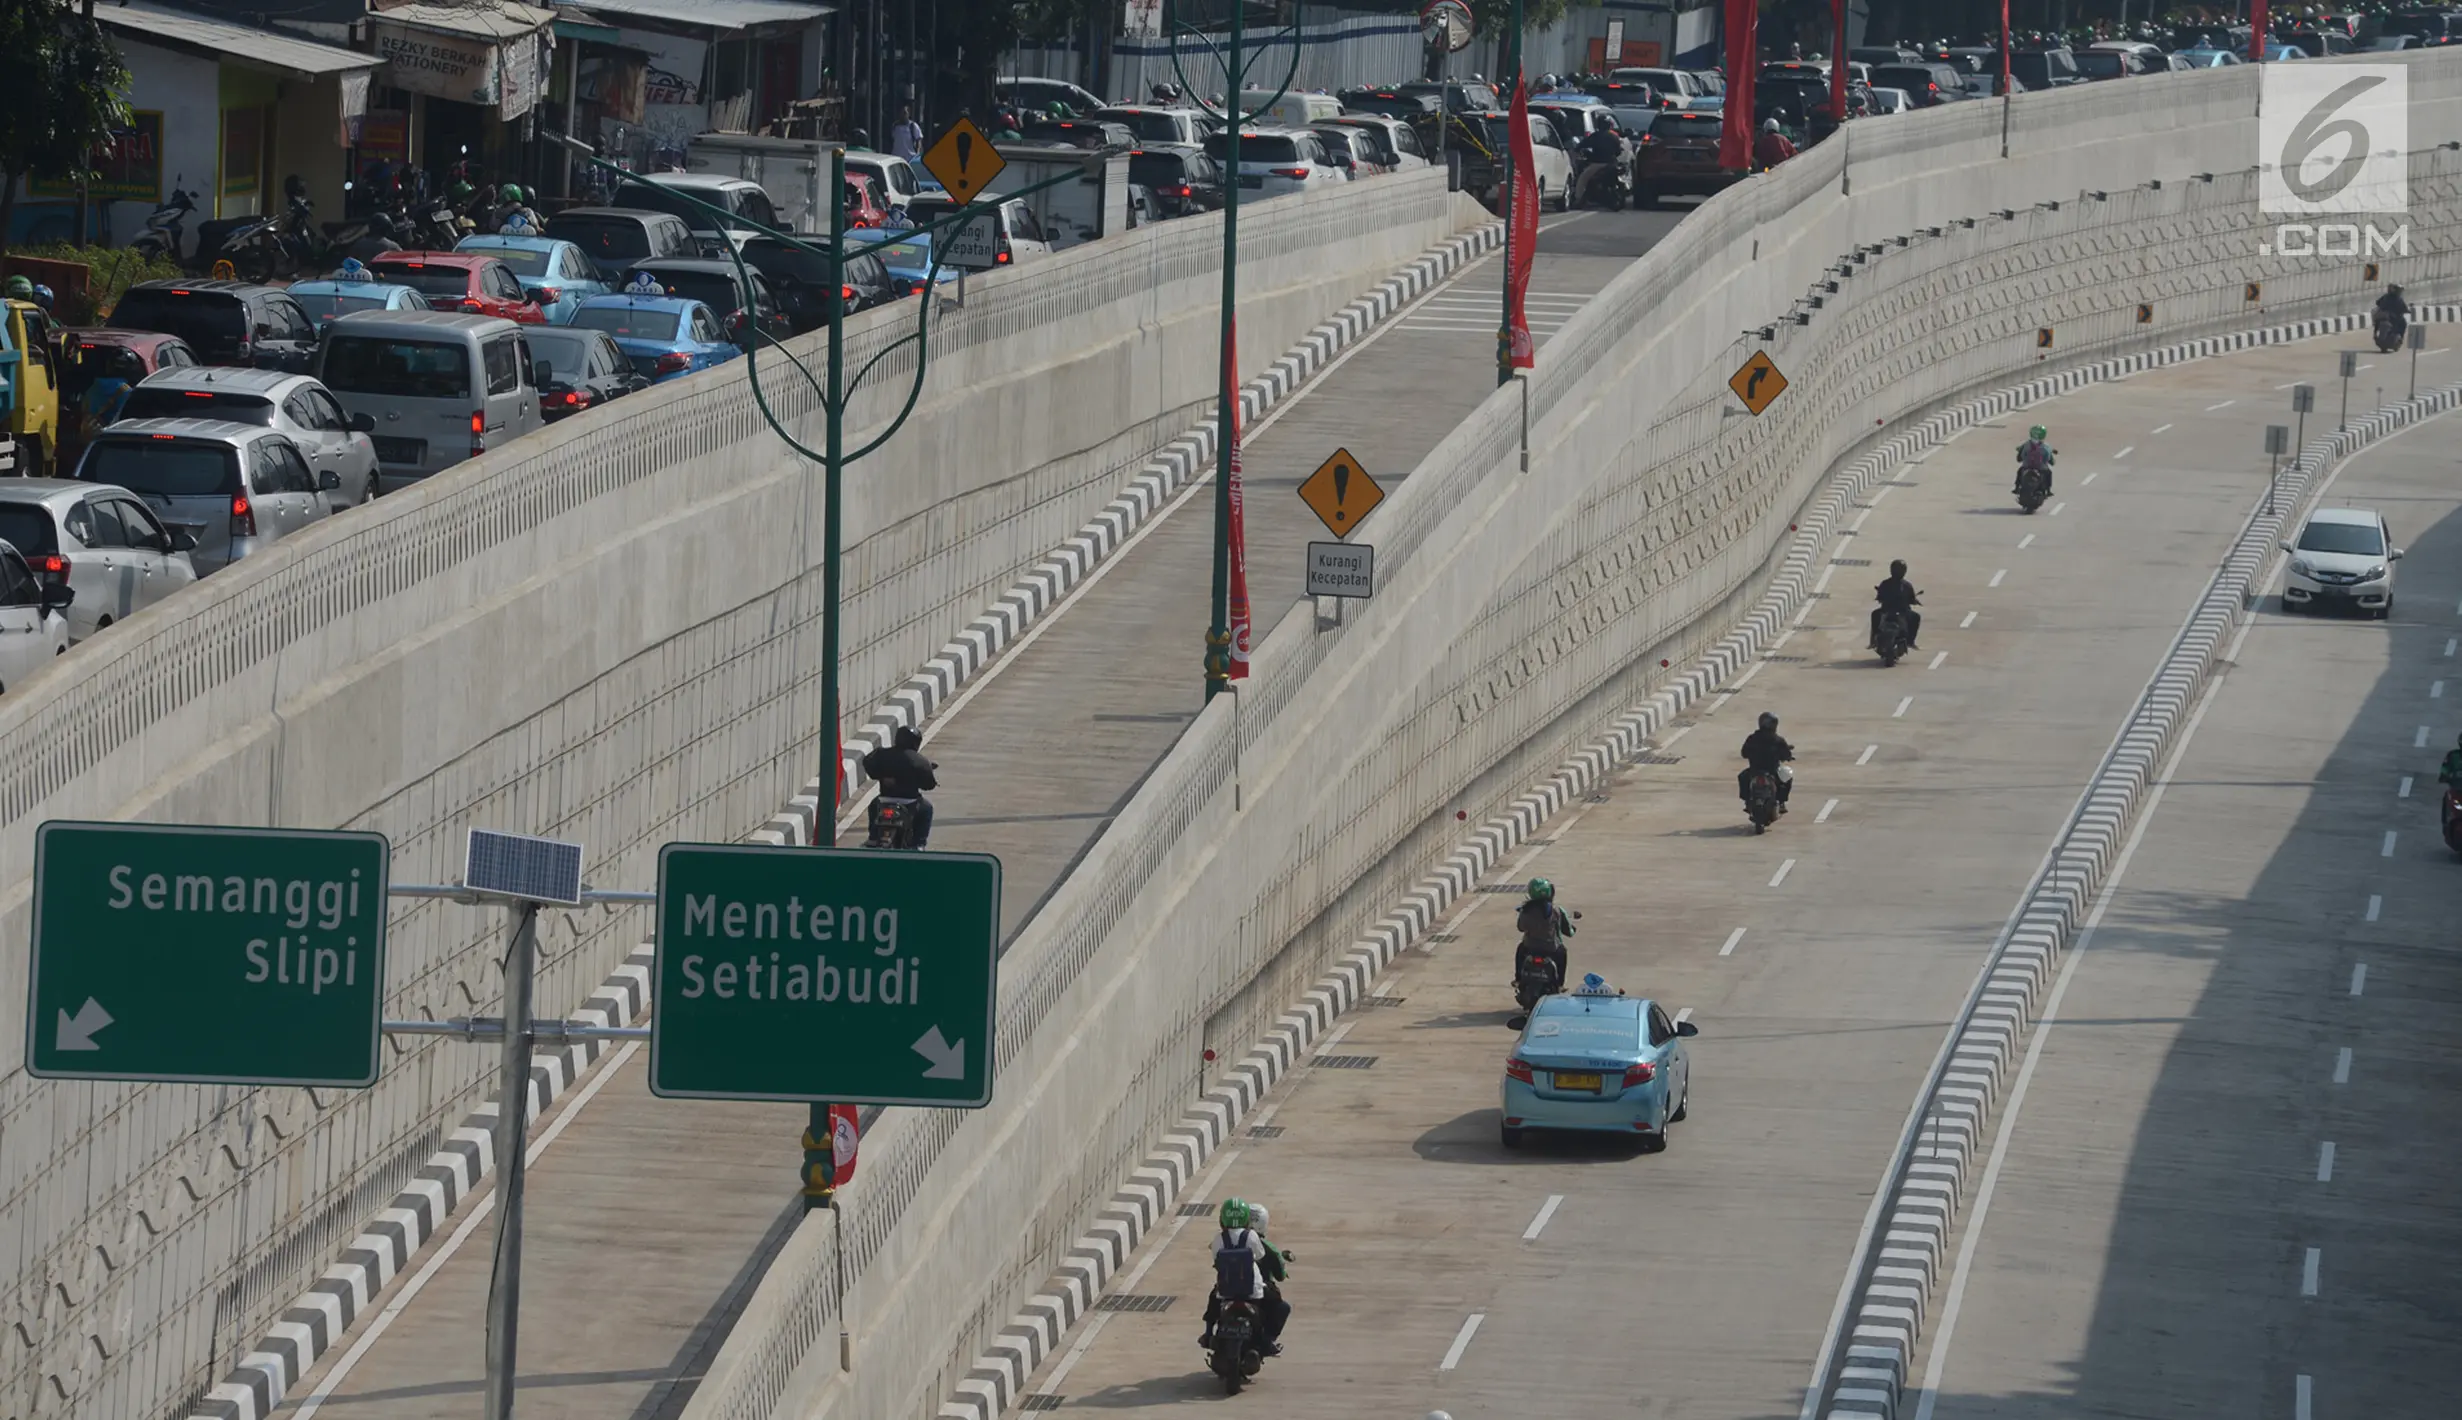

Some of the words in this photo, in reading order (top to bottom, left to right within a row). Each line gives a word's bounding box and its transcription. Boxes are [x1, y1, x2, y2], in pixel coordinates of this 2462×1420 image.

[381, 36, 429, 54] REZKY
[432, 46, 487, 68] BERKAH
[382, 51, 469, 77] STATIONERY
[943, 224, 985, 241] Kuangi
[1319, 554, 1362, 571] Kurangi
[1311, 571, 1369, 588] Kecepatan
[107, 864, 361, 930] Semanggi
[683, 892, 899, 957] Menteng
[244, 935, 357, 996] Slipi
[681, 951, 921, 1006] Setiabudi
